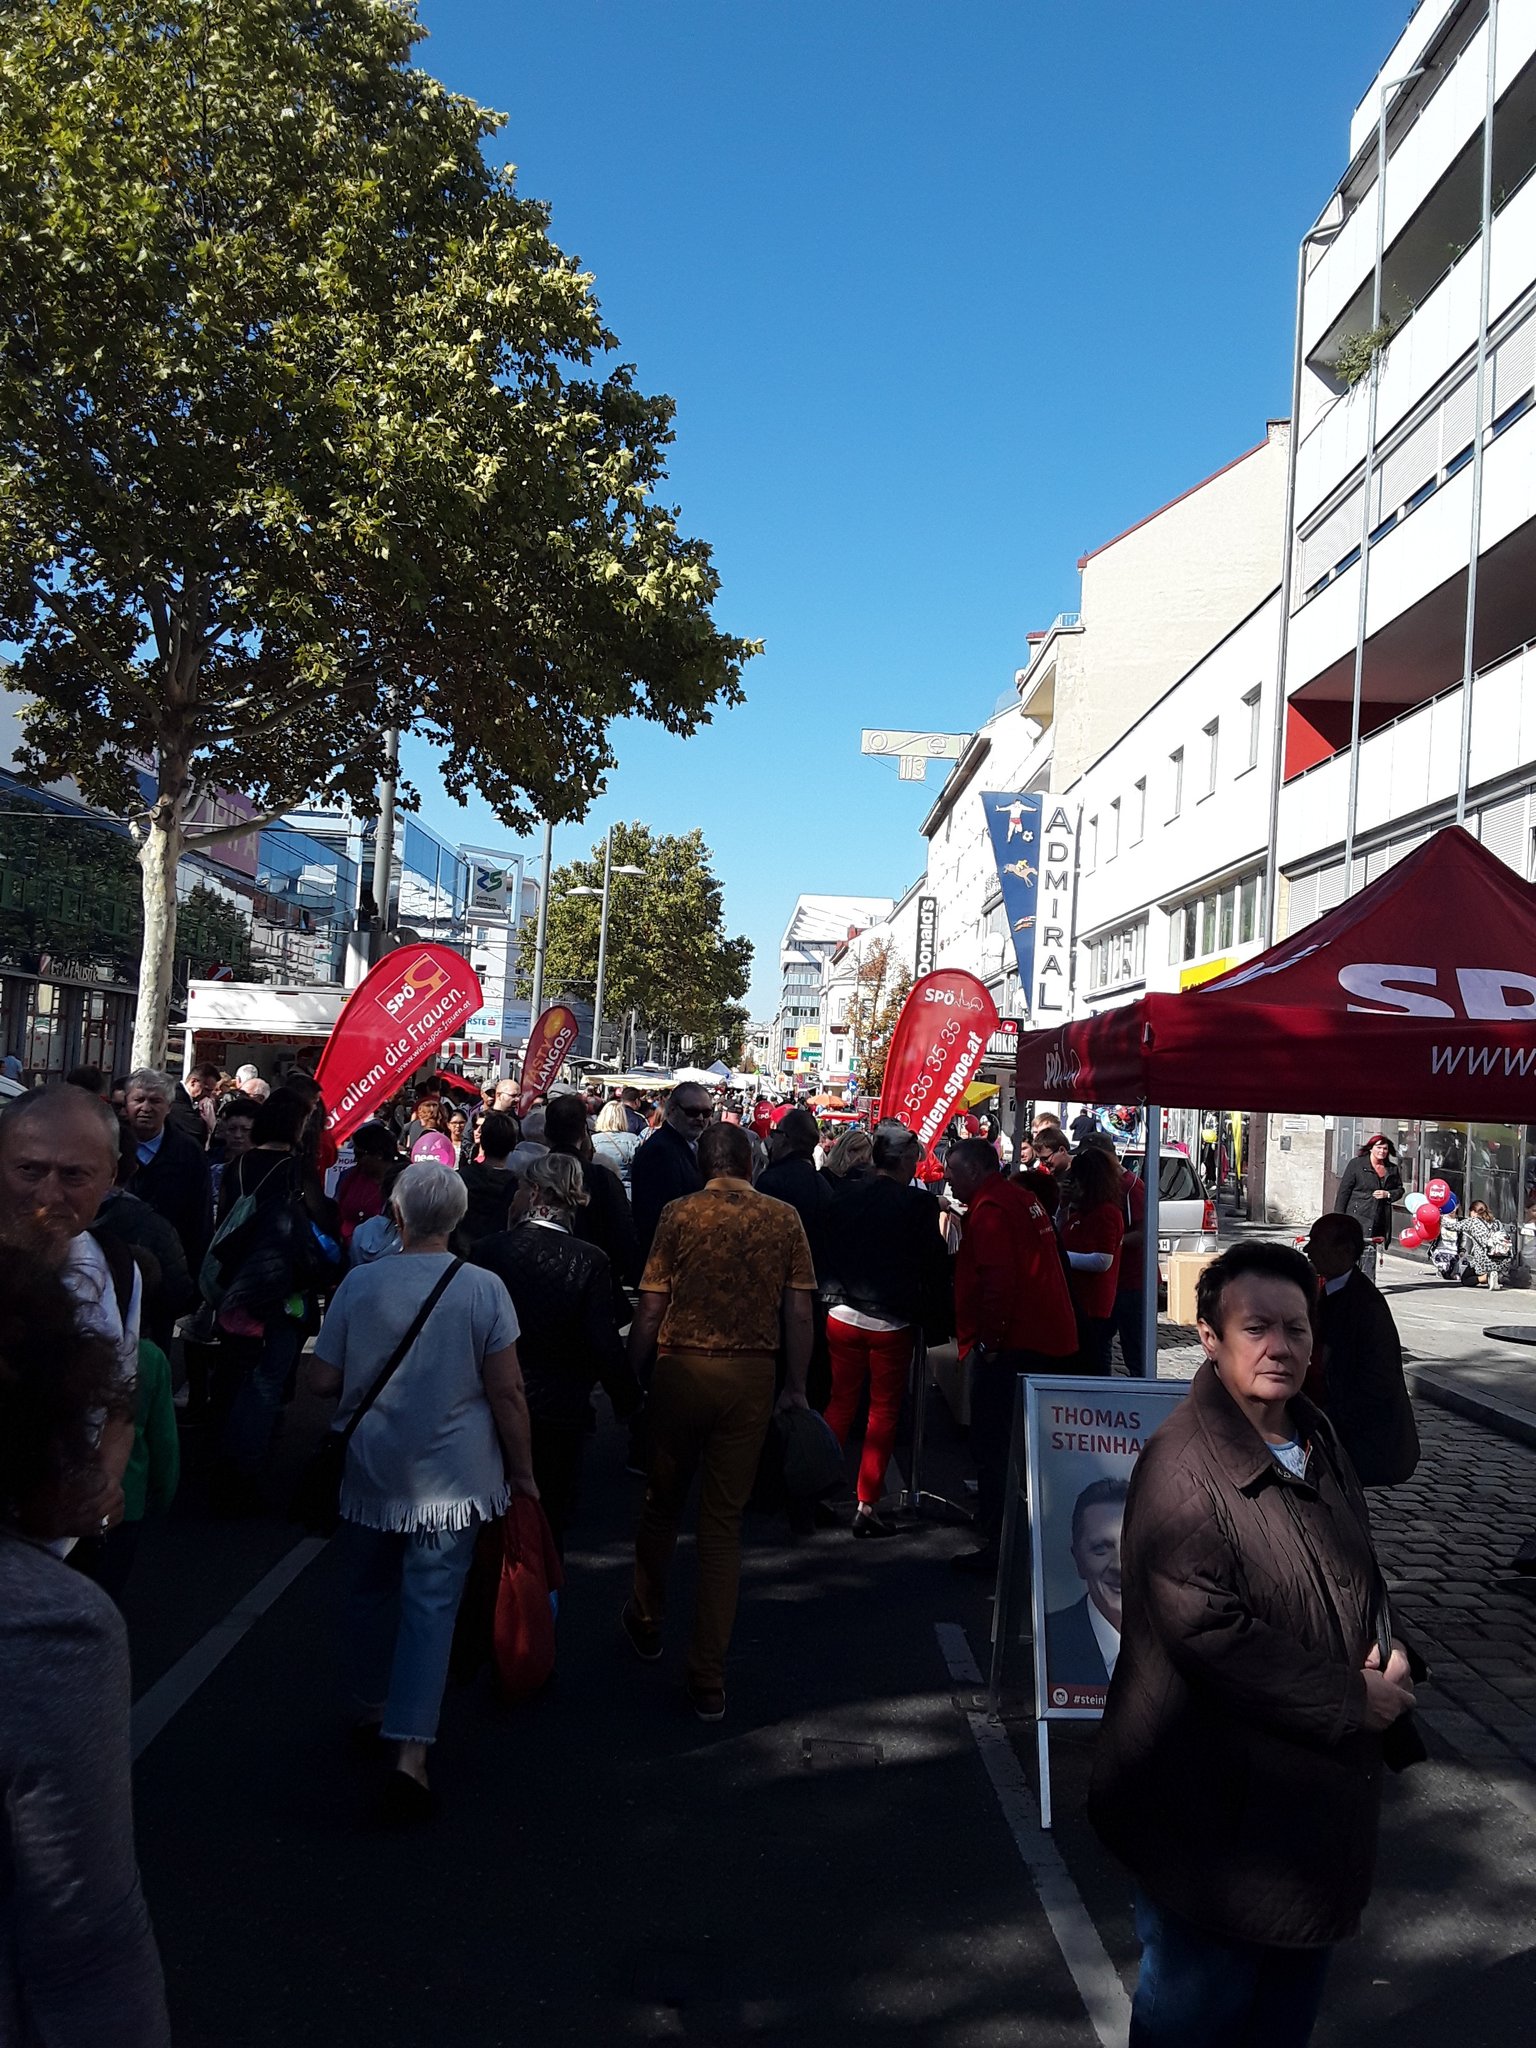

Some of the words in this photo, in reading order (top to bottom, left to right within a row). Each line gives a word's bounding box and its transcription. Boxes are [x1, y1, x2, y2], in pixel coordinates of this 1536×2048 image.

[1038, 806, 1074, 1011] ADMIRAL
[385, 983, 415, 1015] SPÖ
[925, 986, 955, 1006] SPÖ
[342, 1064, 386, 1111] allem
[385, 1038, 411, 1066] die
[406, 986, 466, 1041] Frauen.
[533, 1027, 572, 1091] LANGOS
[904, 1071, 933, 1111] 535
[926, 1043, 948, 1073] 35
[941, 1018, 961, 1046] 35
[917, 1030, 983, 1145] wien.spoe.at
[1051, 1406, 1141, 1430] THOMAS
[1051, 1432, 1149, 1455] STEINHA
